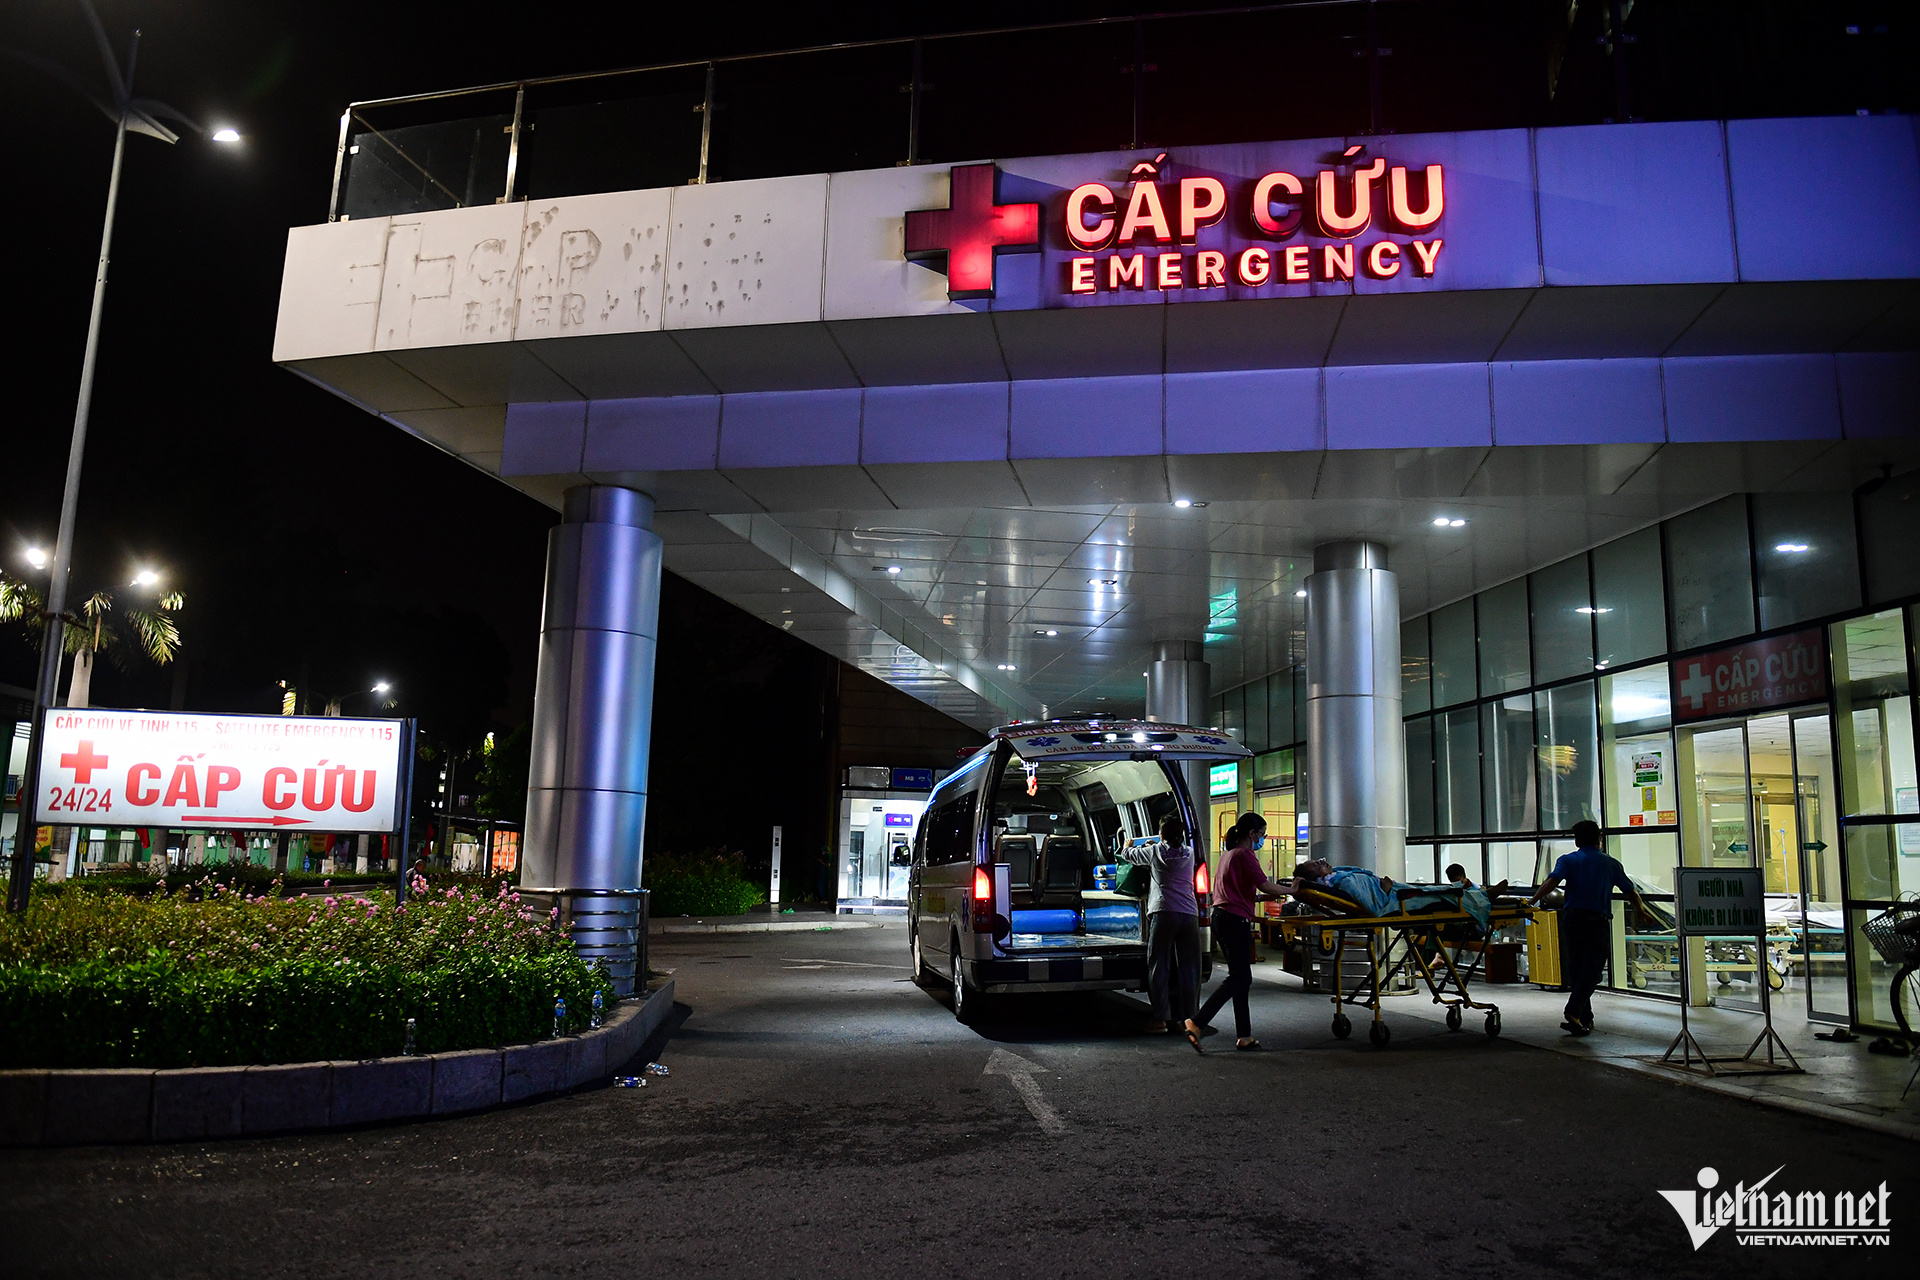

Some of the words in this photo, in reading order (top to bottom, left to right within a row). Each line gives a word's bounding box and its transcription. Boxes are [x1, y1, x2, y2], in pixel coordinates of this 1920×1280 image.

[1066, 152, 1227, 251] CẤP
[1252, 144, 1445, 241] CỨU
[1071, 239, 1443, 294] EMERGENCY
[1715, 650, 1760, 692] CẤP
[1765, 642, 1819, 683] CỨU
[1718, 679, 1820, 707] EMERGENCY
[56, 711, 83, 729] CẤP
[176, 721, 198, 733] 115
[216, 721, 280, 737] SATELLITE
[285, 724, 365, 740] EMERGENCY
[370, 727, 392, 741] 115
[125, 753, 241, 809] CẤP
[262, 759, 377, 813] CỨU
[48, 786, 112, 812] 24/24
[1698, 877, 1725, 897] NGƯỜI
[1727, 878, 1745, 897] NHÀ
[1685, 906, 1714, 926] KHÔNG
[1716, 908, 1726, 926] ĐI
[1743, 906, 1759, 926] NÀY
